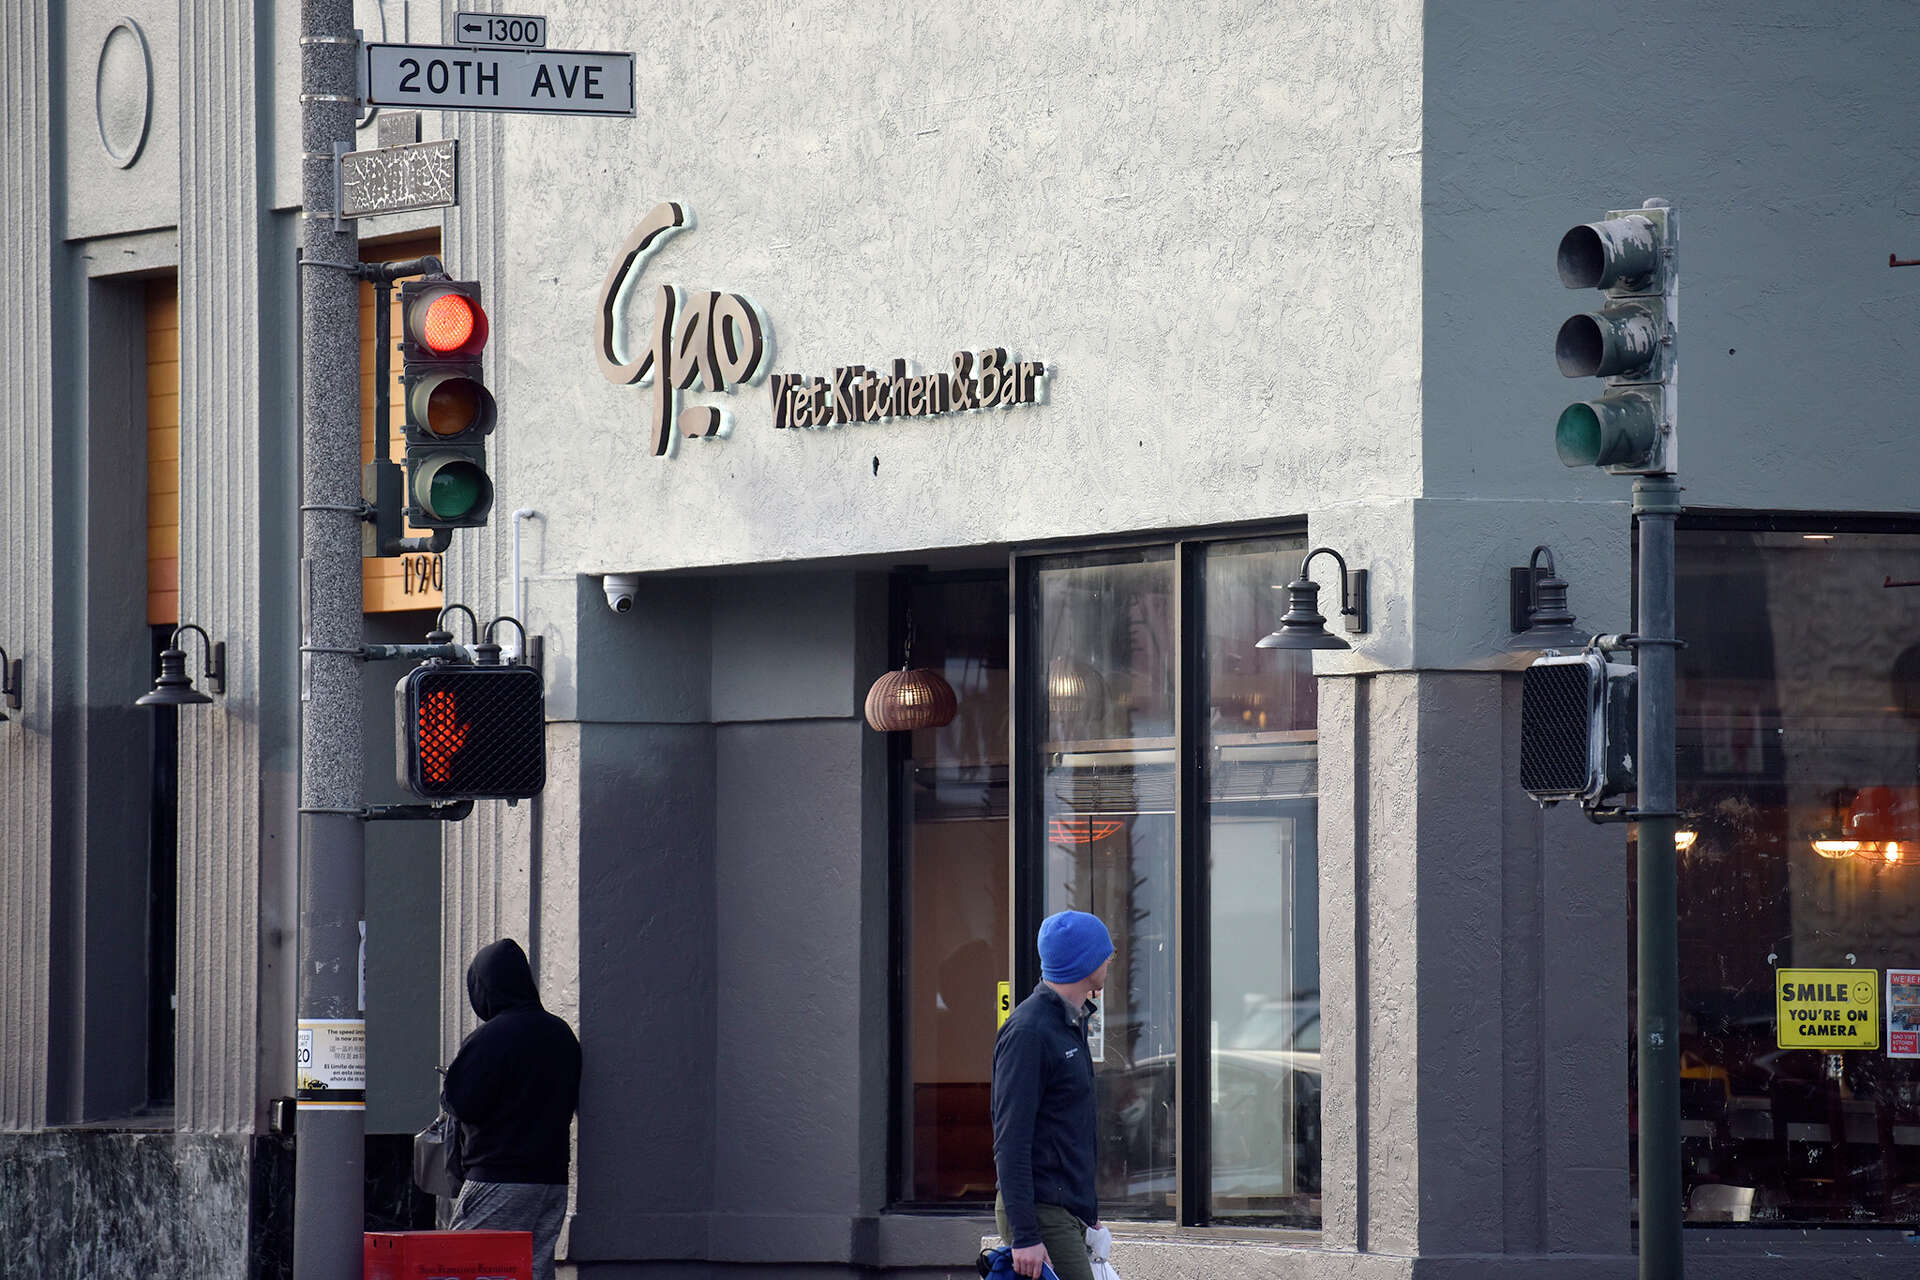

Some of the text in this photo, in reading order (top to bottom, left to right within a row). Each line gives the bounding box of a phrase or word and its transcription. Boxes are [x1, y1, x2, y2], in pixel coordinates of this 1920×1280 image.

[487, 19, 539, 43] 1300
[398, 58, 604, 99] 20TH AVE
[769, 347, 1043, 428] Viet Kitchen & Bar
[1782, 983, 1848, 1002] SMILE
[1789, 1009, 1868, 1021] YOU'RE ON
[1799, 1025, 1857, 1036] CAMERA
